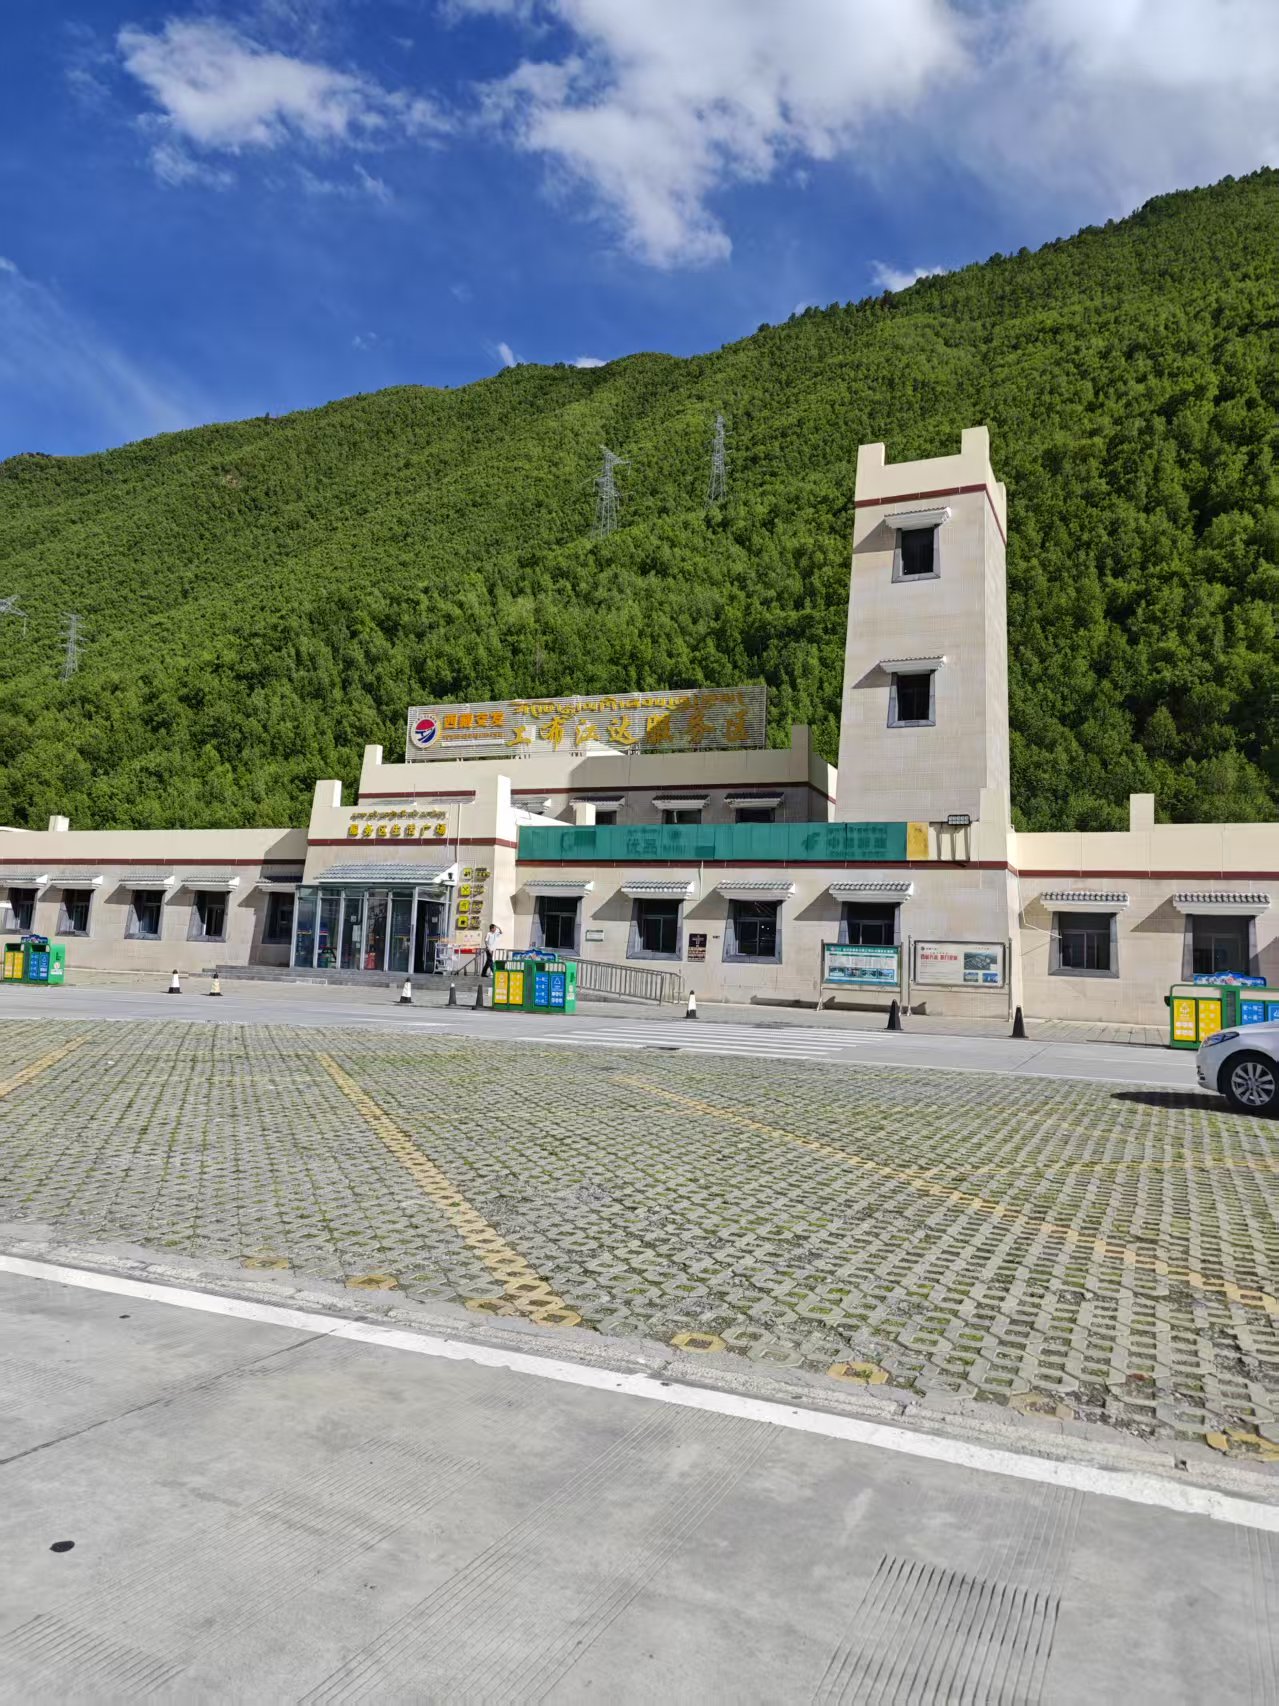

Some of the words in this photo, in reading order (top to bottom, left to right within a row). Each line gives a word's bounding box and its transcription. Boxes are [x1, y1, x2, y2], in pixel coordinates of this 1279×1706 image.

[348, 823, 447, 837] 服务区生活广场
